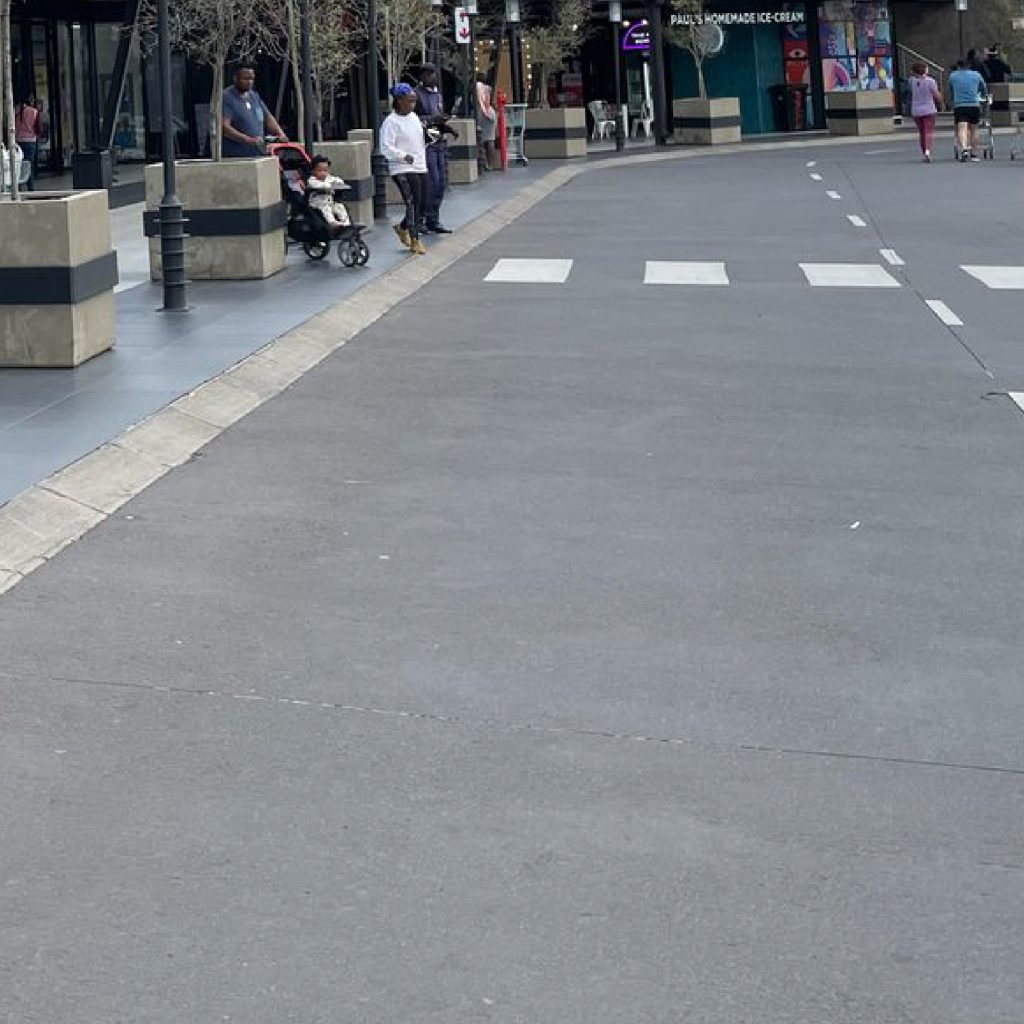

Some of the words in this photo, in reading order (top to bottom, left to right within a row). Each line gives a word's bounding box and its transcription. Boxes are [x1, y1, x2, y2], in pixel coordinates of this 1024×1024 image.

[670, 14, 704, 25] PAUL'S
[704, 13, 756, 24] HOMEMADE
[757, 12, 804, 23] ICE-CREAM
